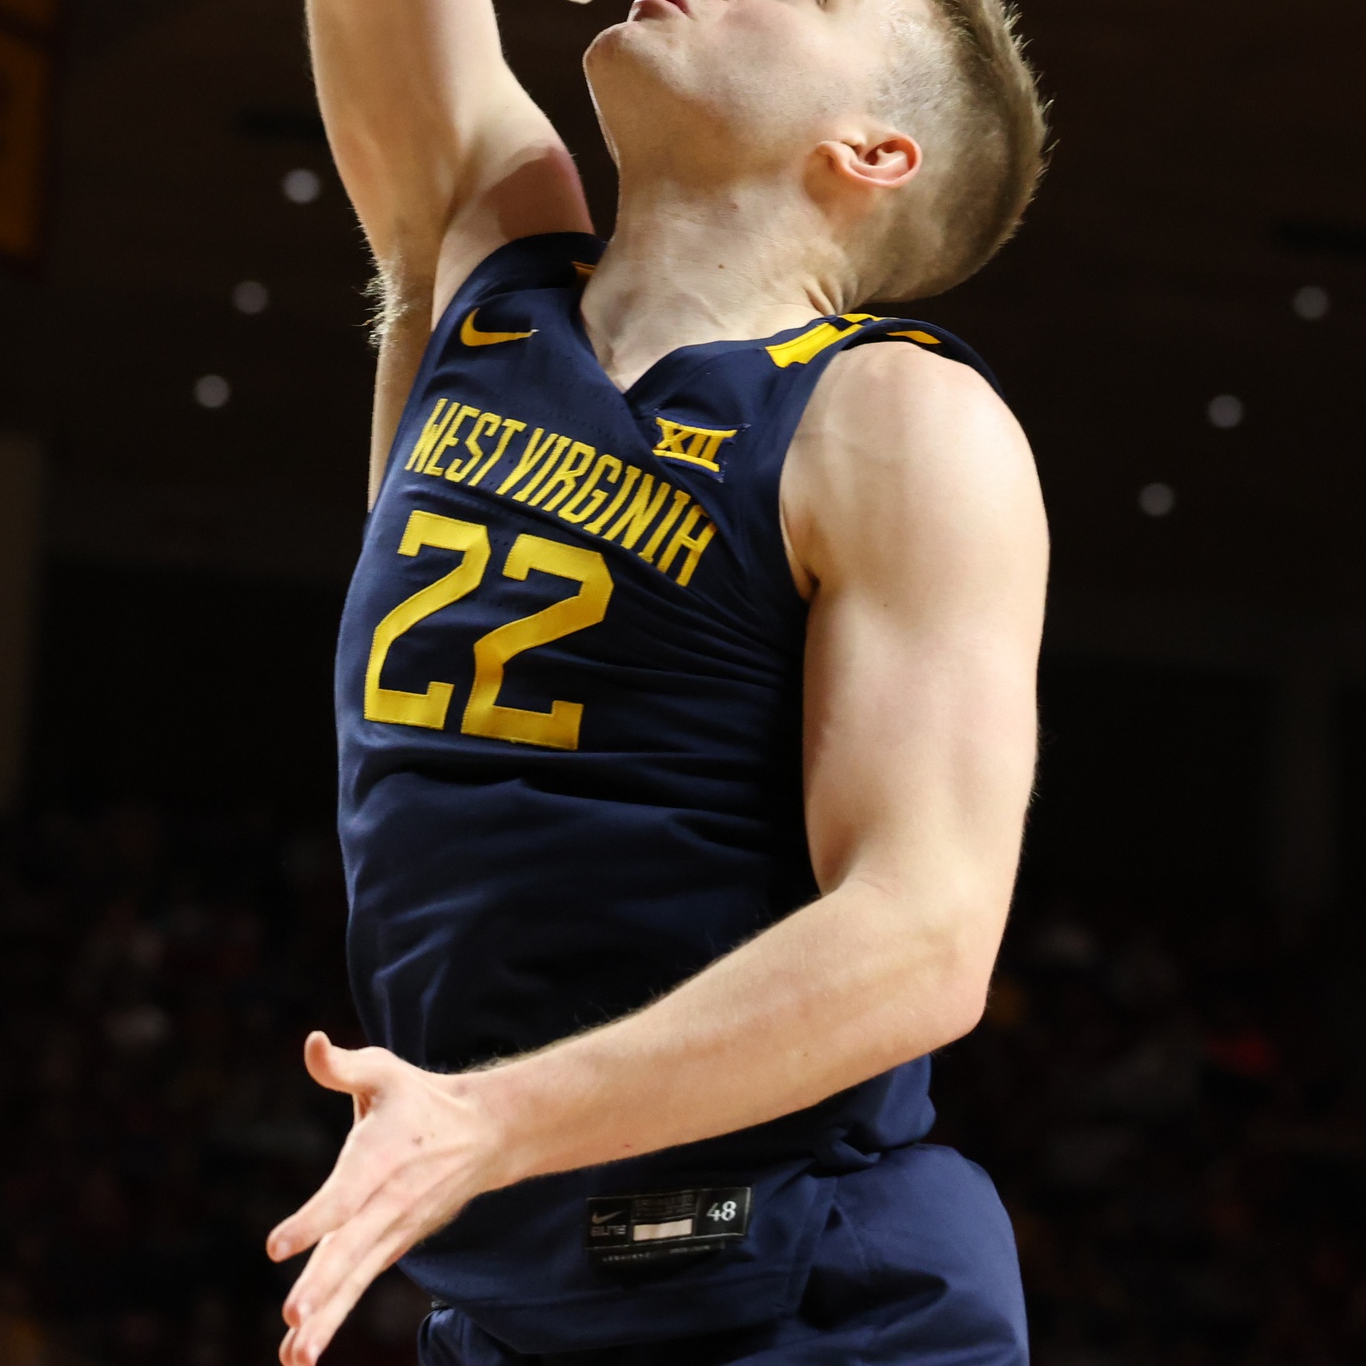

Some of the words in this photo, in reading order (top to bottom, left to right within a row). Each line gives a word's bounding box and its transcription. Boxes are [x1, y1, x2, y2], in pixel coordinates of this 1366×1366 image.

[405, 398, 527, 486] WEST
[496, 428, 718, 587] VIRGINIA
[364, 510, 614, 751] 22
[706, 1200, 737, 1222] 48
